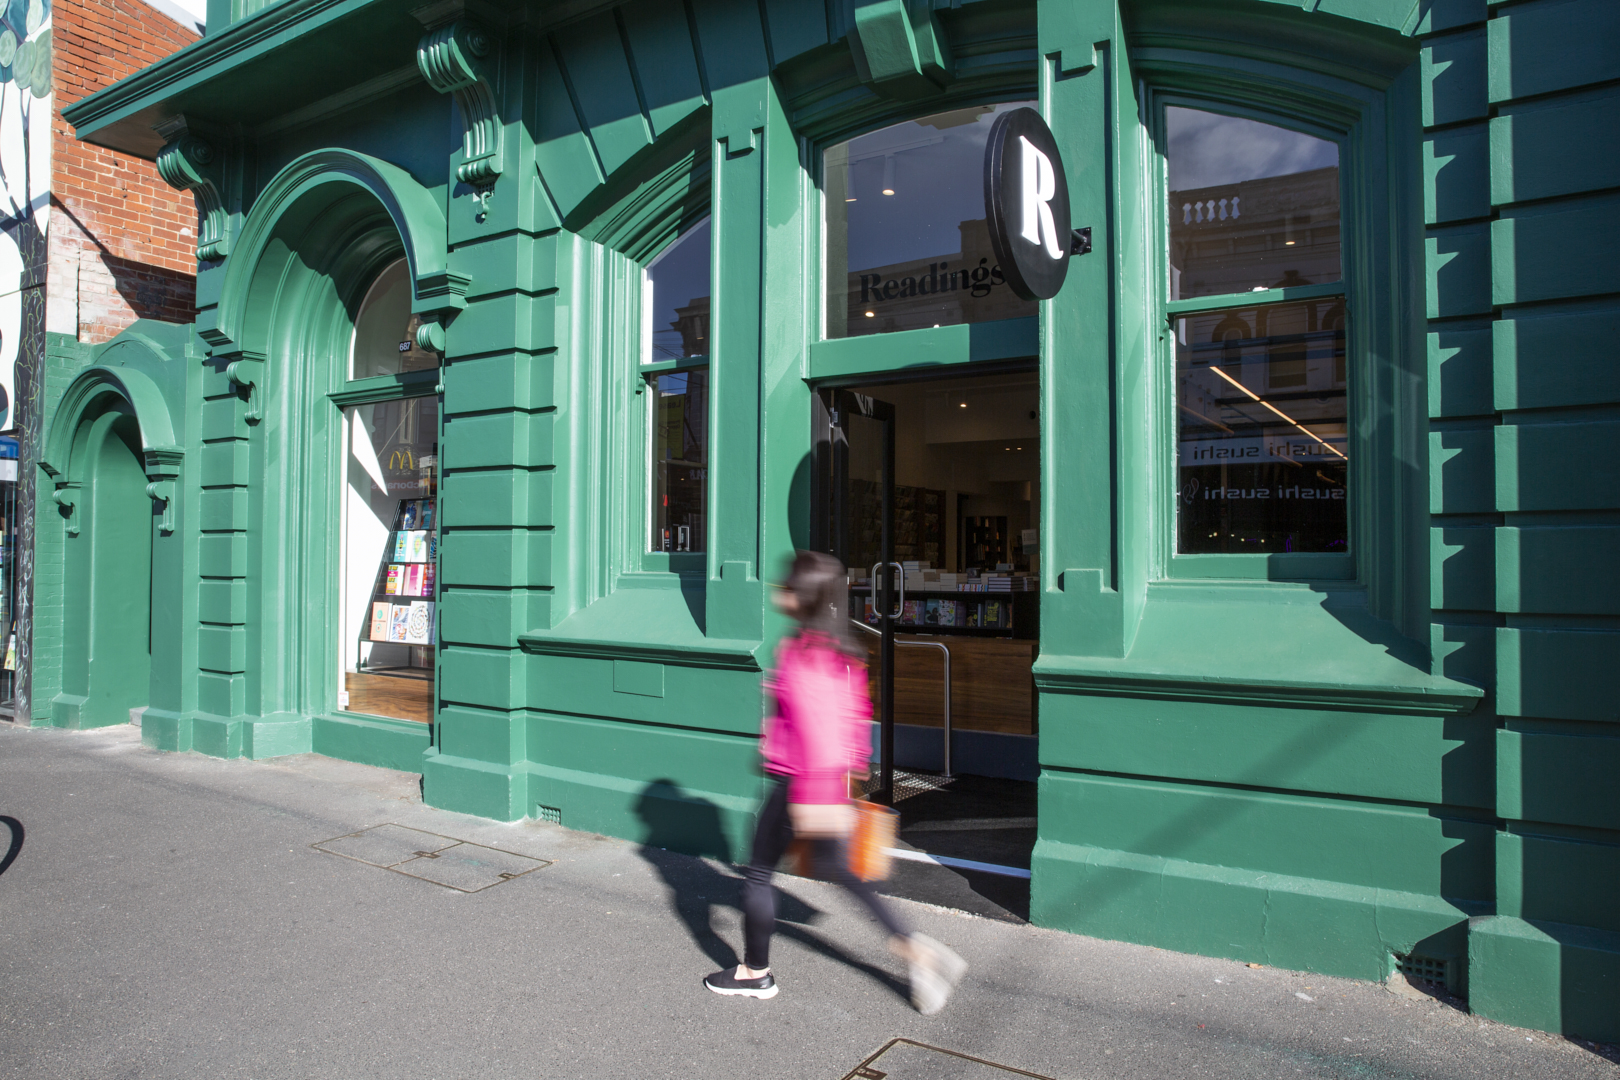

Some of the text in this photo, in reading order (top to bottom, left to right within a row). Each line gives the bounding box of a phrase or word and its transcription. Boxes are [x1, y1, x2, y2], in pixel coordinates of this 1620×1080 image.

[1019, 135, 1064, 260] R
[859, 257, 1006, 304] Readings
[399, 341, 411, 351] 687
